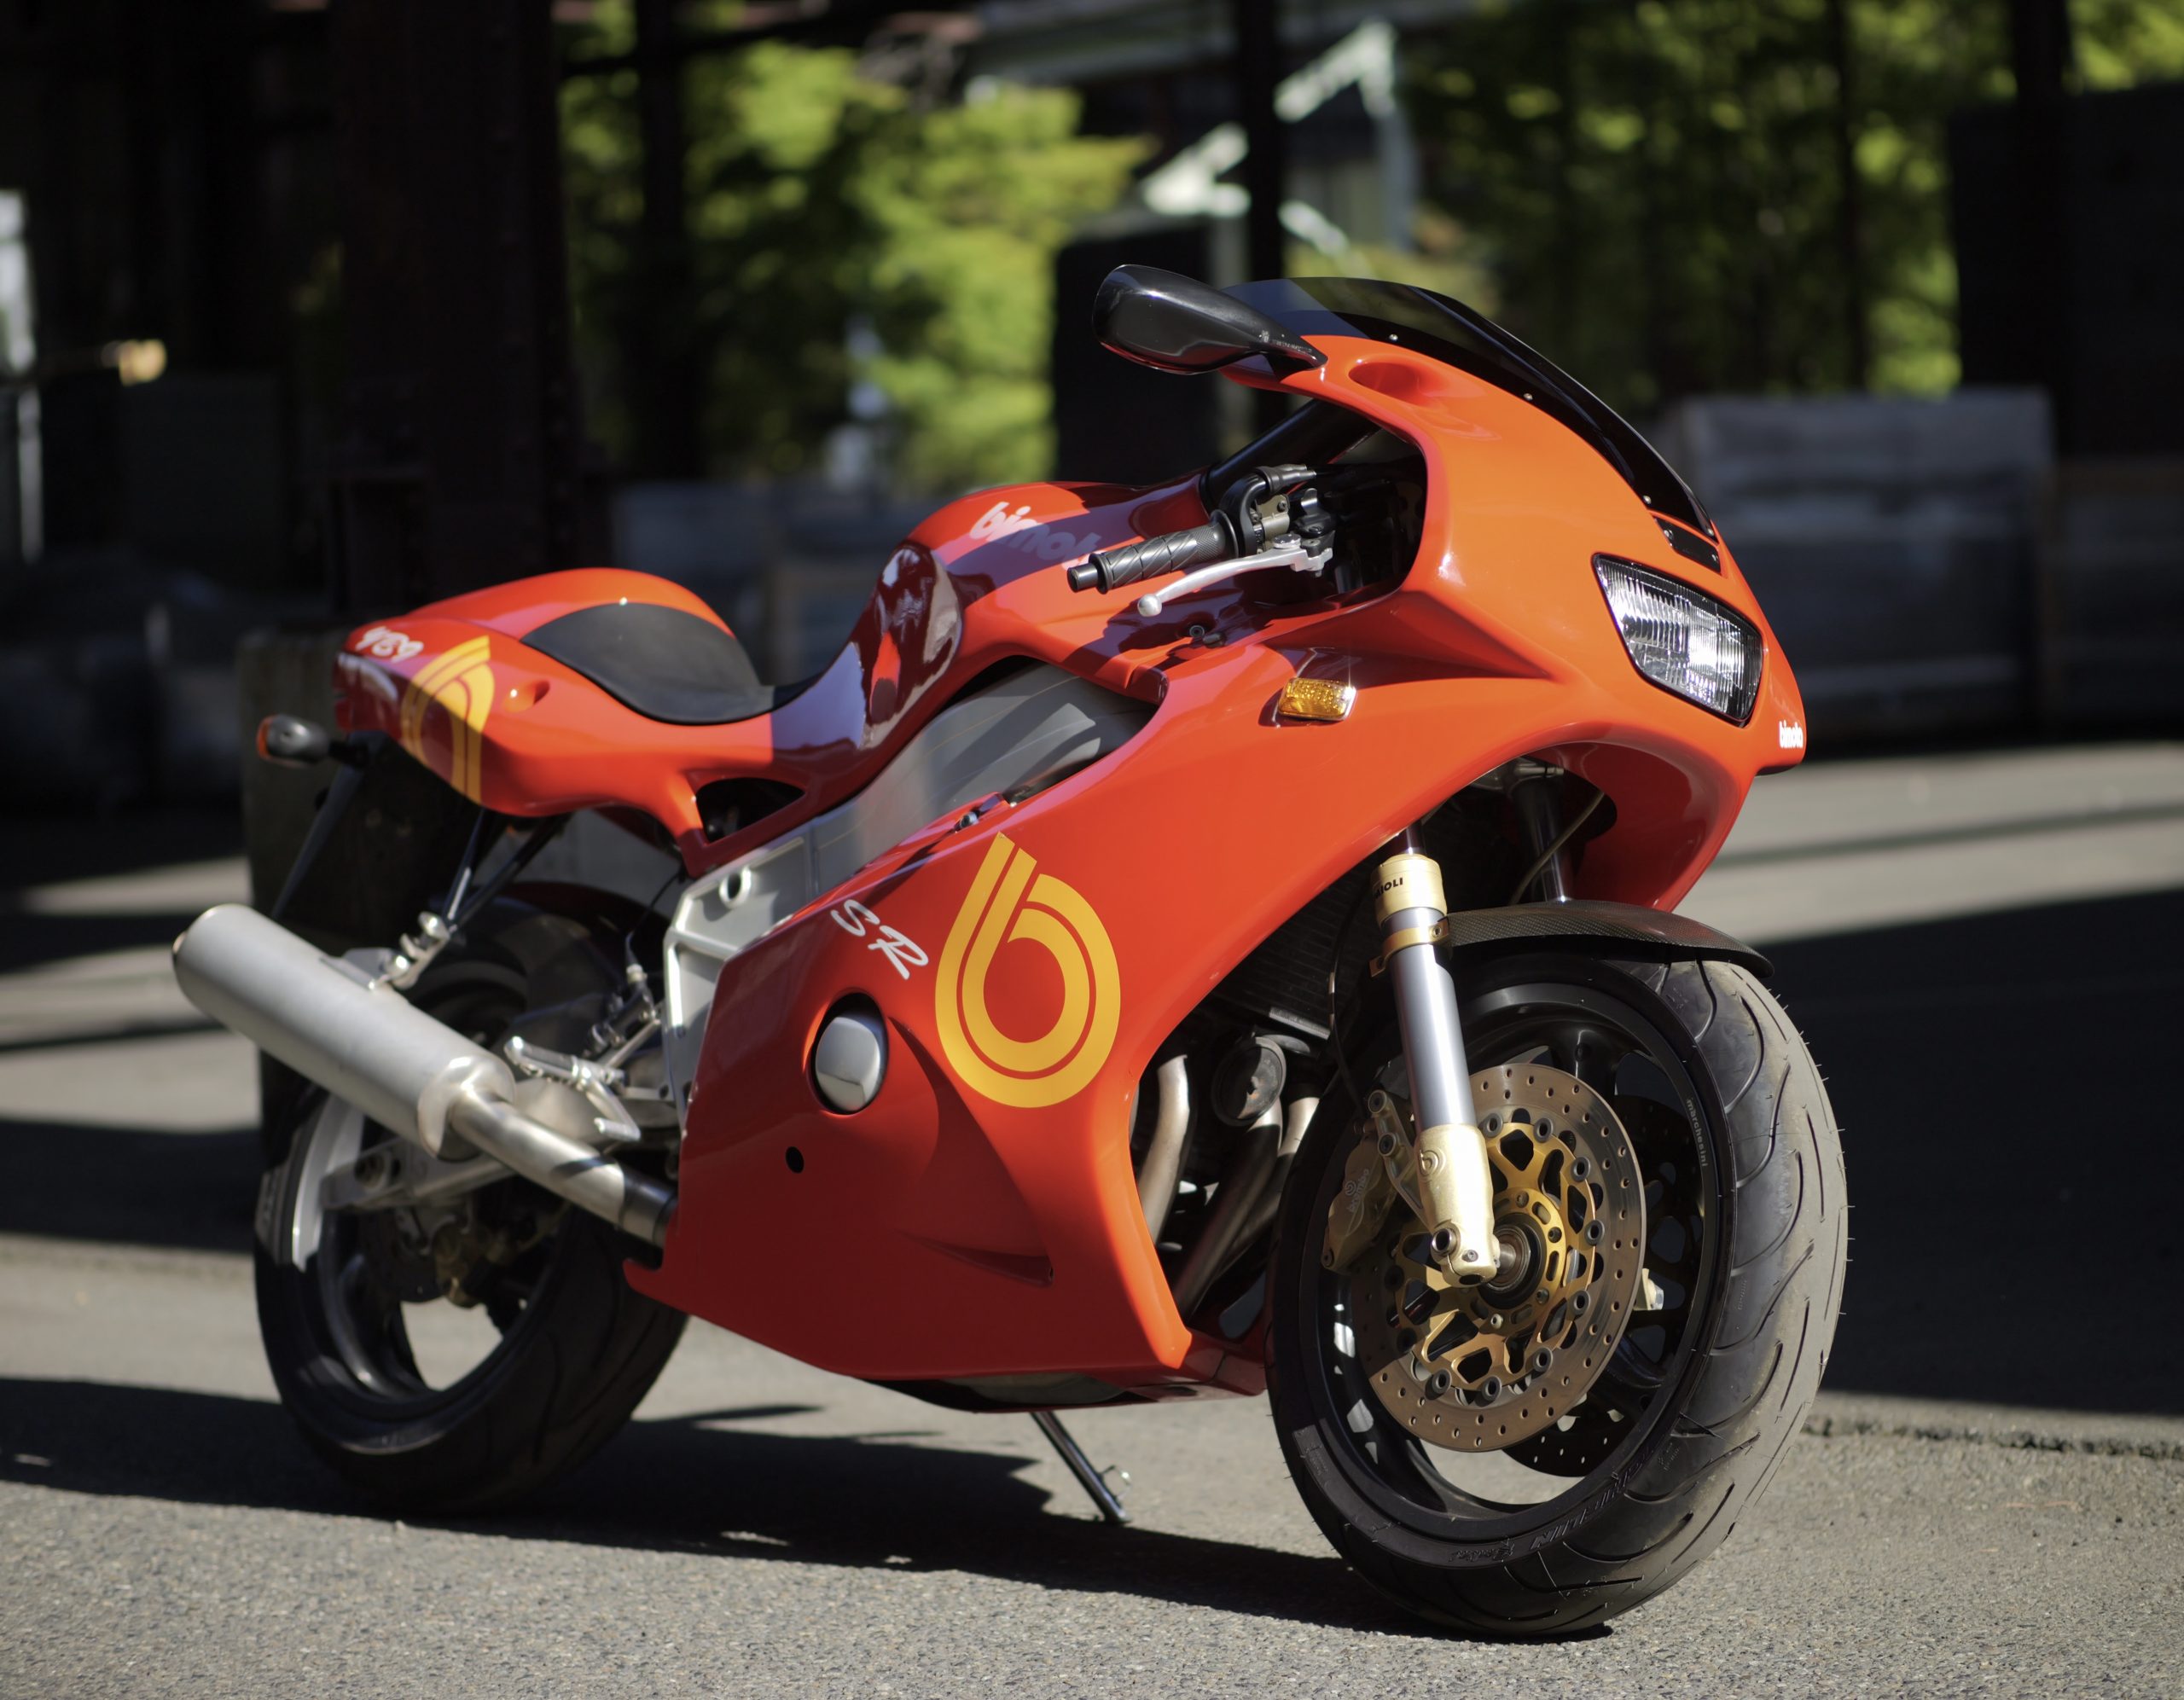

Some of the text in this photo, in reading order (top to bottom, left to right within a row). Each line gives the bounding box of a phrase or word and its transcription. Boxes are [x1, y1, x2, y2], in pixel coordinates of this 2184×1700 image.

[969, 501, 1108, 572] bimot
[830, 899, 929, 980] SR
[1686, 1098, 1709, 1167] marchesini
